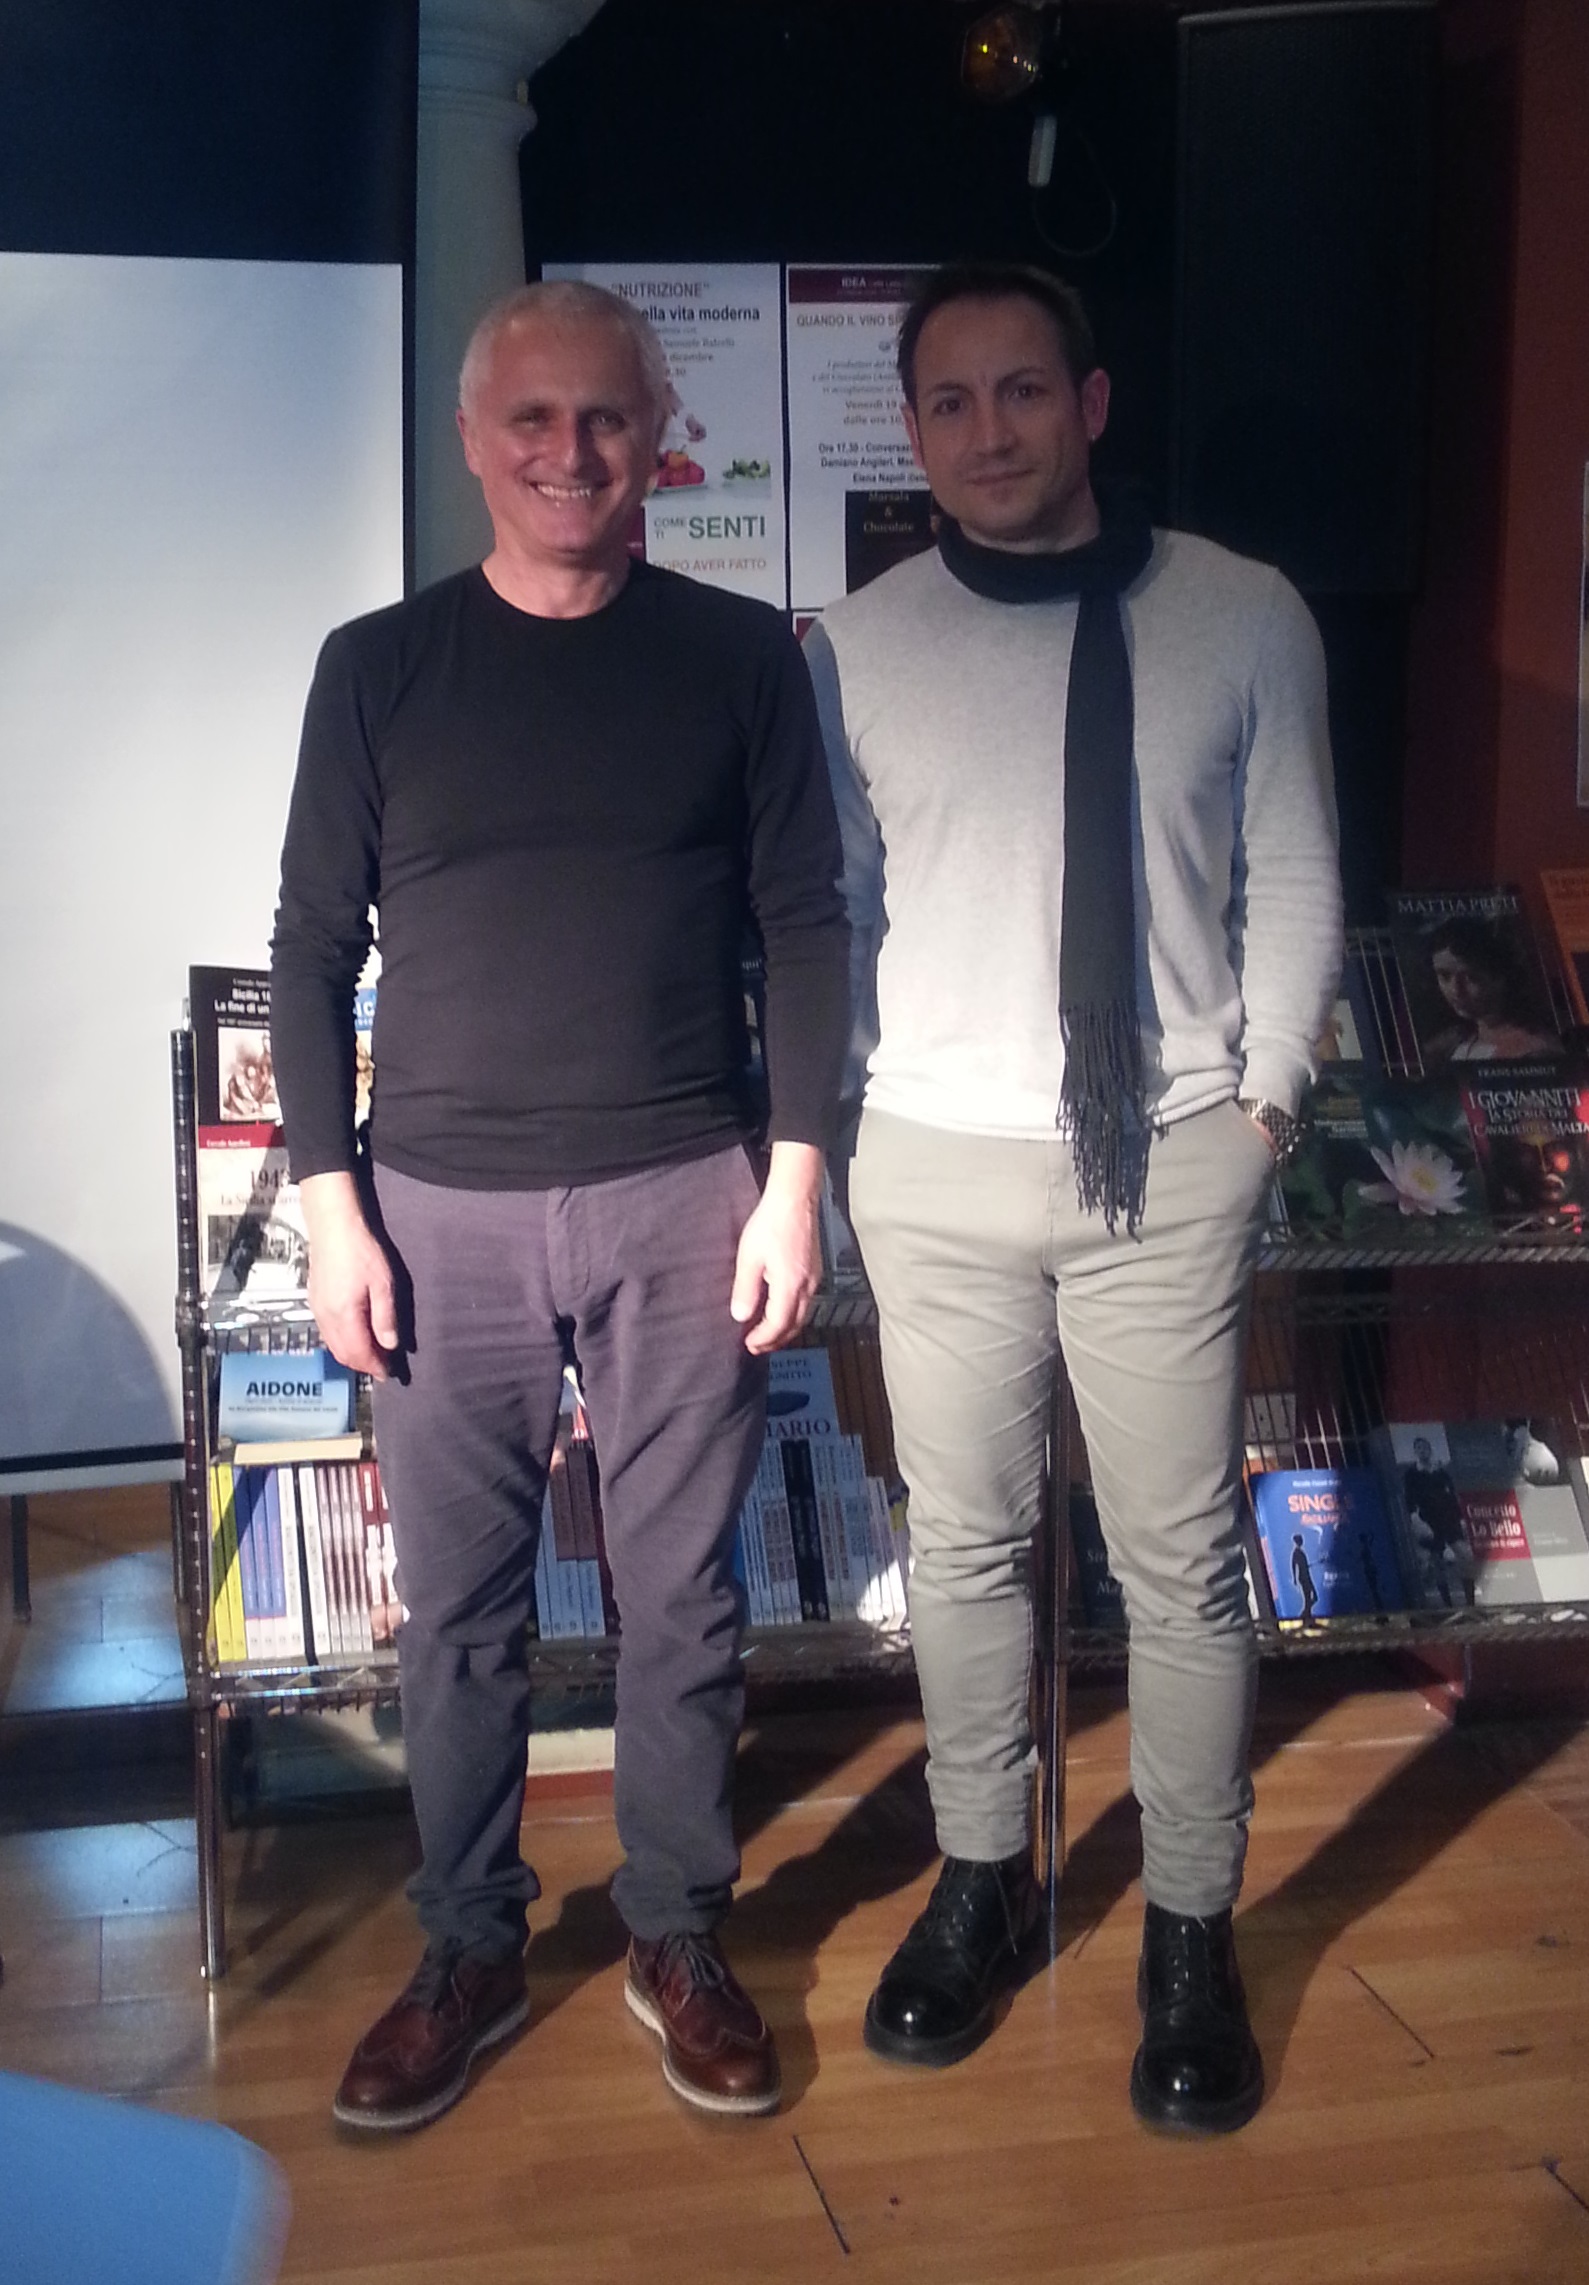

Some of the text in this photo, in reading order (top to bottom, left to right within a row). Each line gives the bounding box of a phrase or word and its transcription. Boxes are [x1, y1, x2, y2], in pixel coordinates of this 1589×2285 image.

[841, 277, 867, 288] IDEA
[639, 304, 761, 321] ella vita moderna
[796, 314, 845, 327] QUANDO
[847, 315, 855, 326] IL
[859, 314, 885, 326] VINO
[818, 443, 834, 454] Ore
[820, 457, 858, 467] Damiano
[853, 473, 877, 483] Elena
[879, 473, 906, 484] Napoli
[868, 490, 910, 501] Marsala
[884, 505, 893, 516] &
[653, 515, 766, 539] COME SENTI
[863, 521, 914, 532] Chocolate
[655, 530, 665, 540] TI
[693, 559, 726, 571] AVER
[728, 558, 767, 570] FATTO
[1397, 898, 1467, 914] MATTIA
[213, 999, 227, 1013] La
[227, 1000, 245, 1014] fine
[246, 1001, 256, 1015] di
[1477, 1087, 1581, 1110] GIOVANNITI
[245, 1381, 324, 1397] AIDONE
[766, 1418, 832, 1437] IARIO
[1466, 1503, 1517, 1518] Concetto
[1470, 1519, 1522, 1537] Lo Bello
